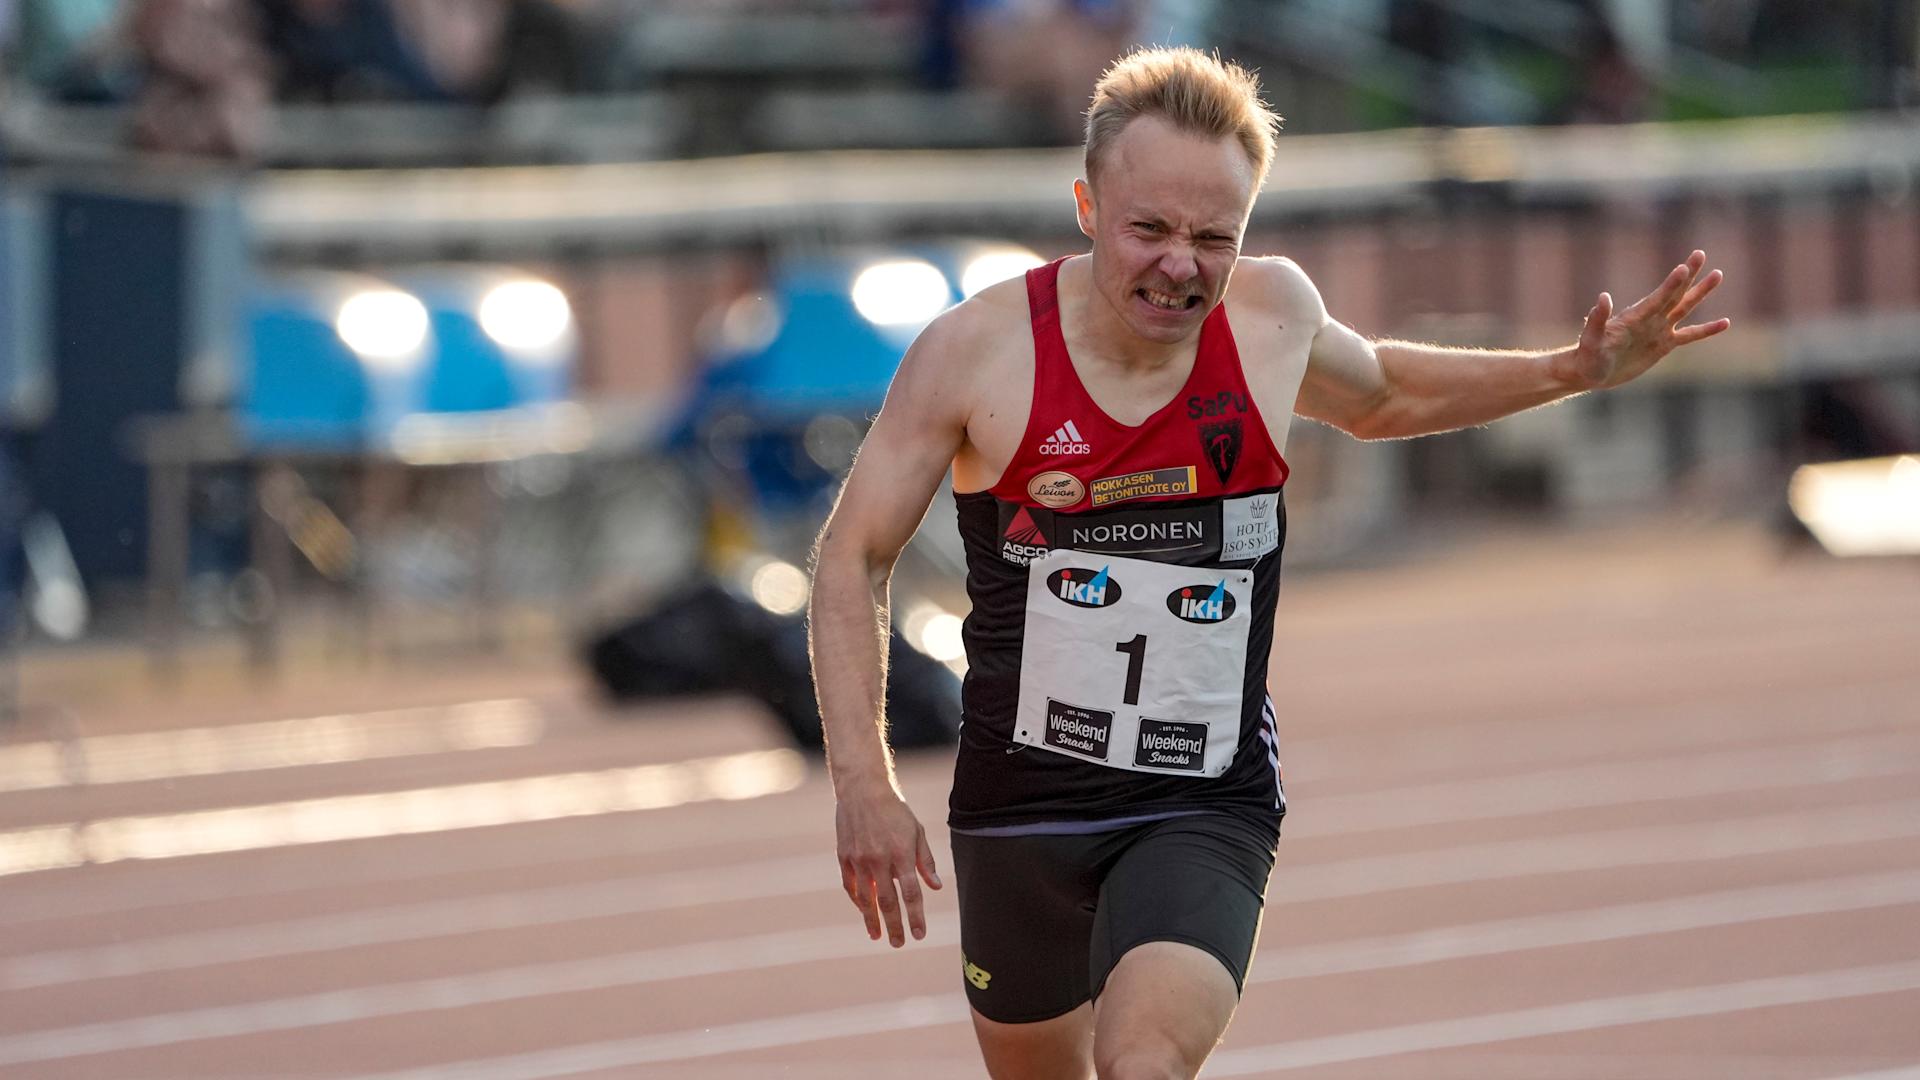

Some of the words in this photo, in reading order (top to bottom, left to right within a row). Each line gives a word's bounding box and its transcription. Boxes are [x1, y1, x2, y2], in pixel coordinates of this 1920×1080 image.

[1187, 391, 1248, 419] SaPu
[1039, 441, 1090, 455] adidas
[1092, 473, 1154, 493] HOKKASEN
[1094, 483, 1169, 505] BETONITUOTE
[1171, 481, 1187, 492] OY
[1073, 520, 1203, 544] NORONEN
[1003, 541, 1049, 557] AGCO
[1115, 633, 1147, 706] 1
[1050, 713, 1108, 743] Weekend
[1056, 733, 1094, 752] Snacks
[1142, 733, 1203, 755] Weekend
[1148, 751, 1190, 765] Snacks
